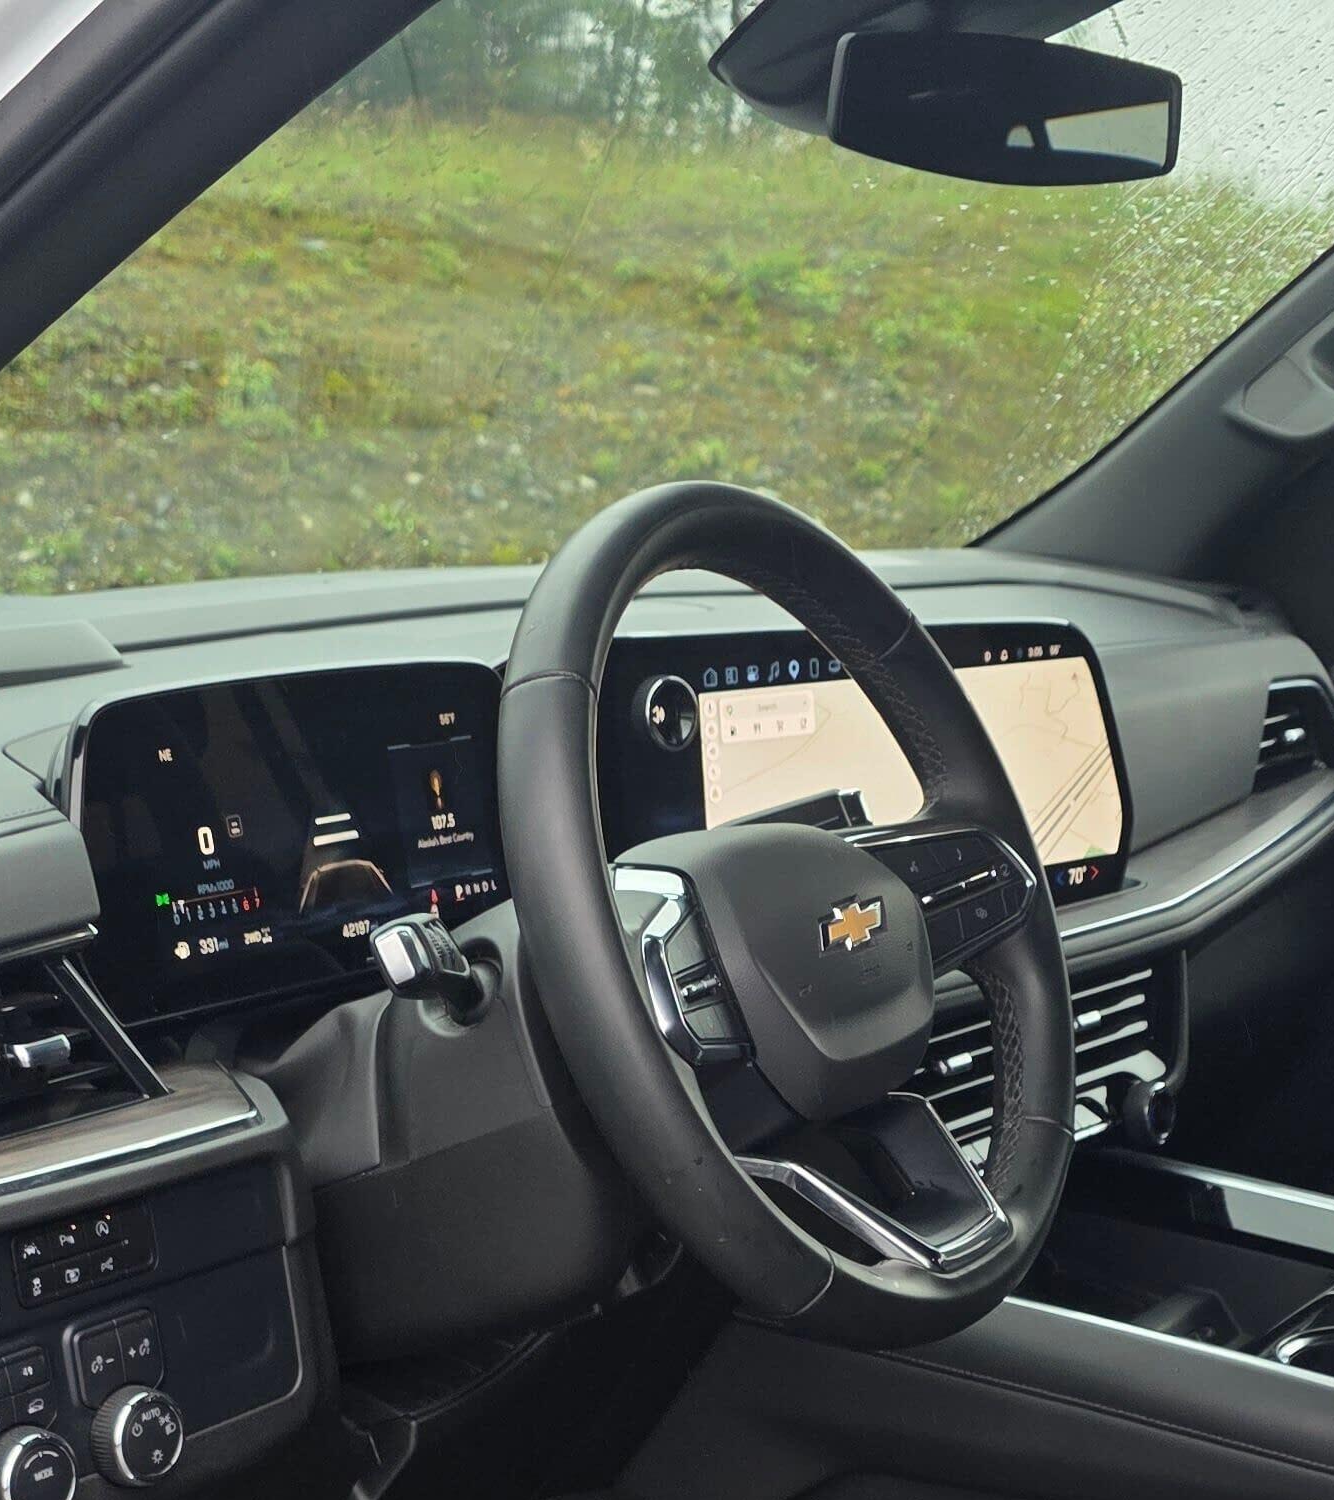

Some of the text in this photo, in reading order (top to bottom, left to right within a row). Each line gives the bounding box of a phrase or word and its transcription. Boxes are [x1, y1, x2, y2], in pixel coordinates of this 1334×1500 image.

[158, 748, 173, 762] NE
[430, 812, 456, 830] 107.5
[197, 826, 215, 855] 0
[202, 858, 221, 871] MPH
[141, 1407, 161, 1422] AUTO
[33, 1466, 55, 1482] MODE
